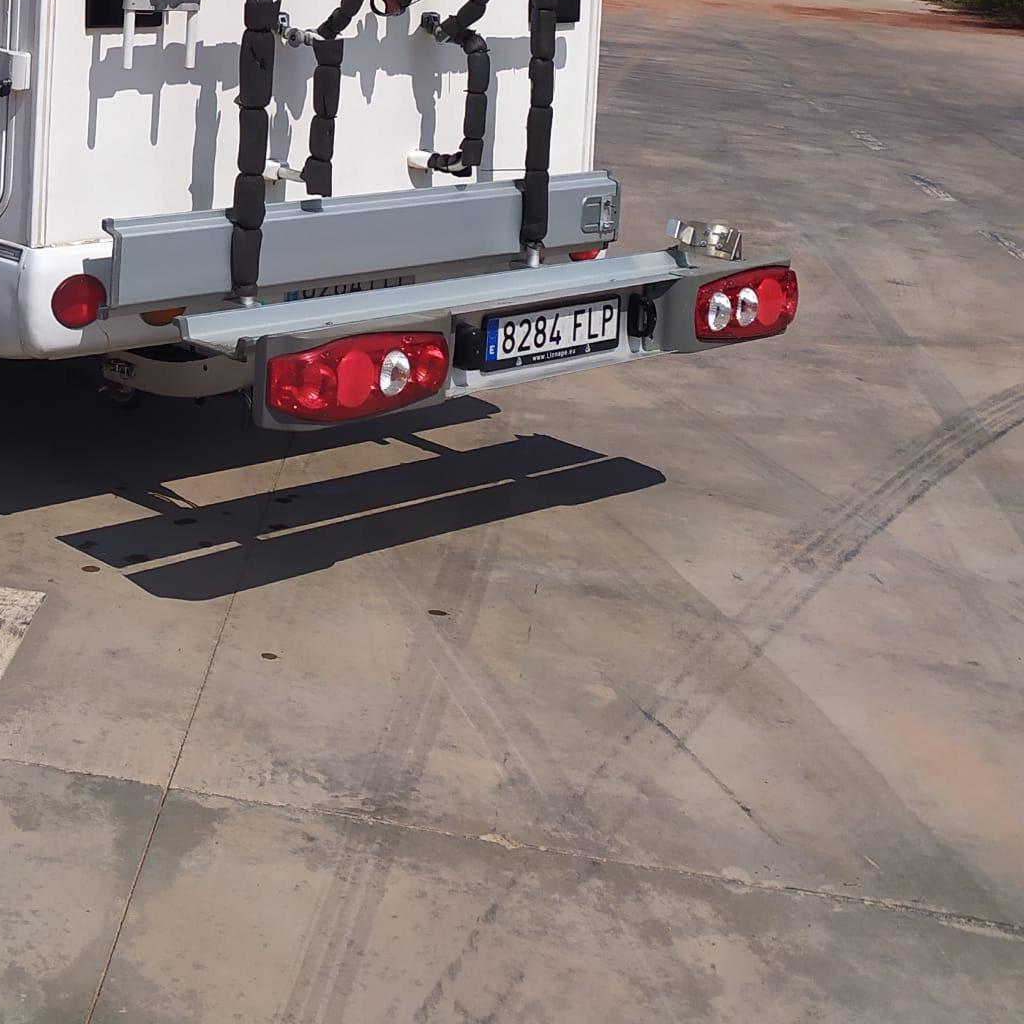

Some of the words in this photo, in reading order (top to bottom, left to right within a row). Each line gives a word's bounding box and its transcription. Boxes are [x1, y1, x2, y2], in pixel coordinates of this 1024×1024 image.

[489, 345, 496, 355] E
[502, 313, 562, 354] 8284
[573, 304, 614, 342] FLP
